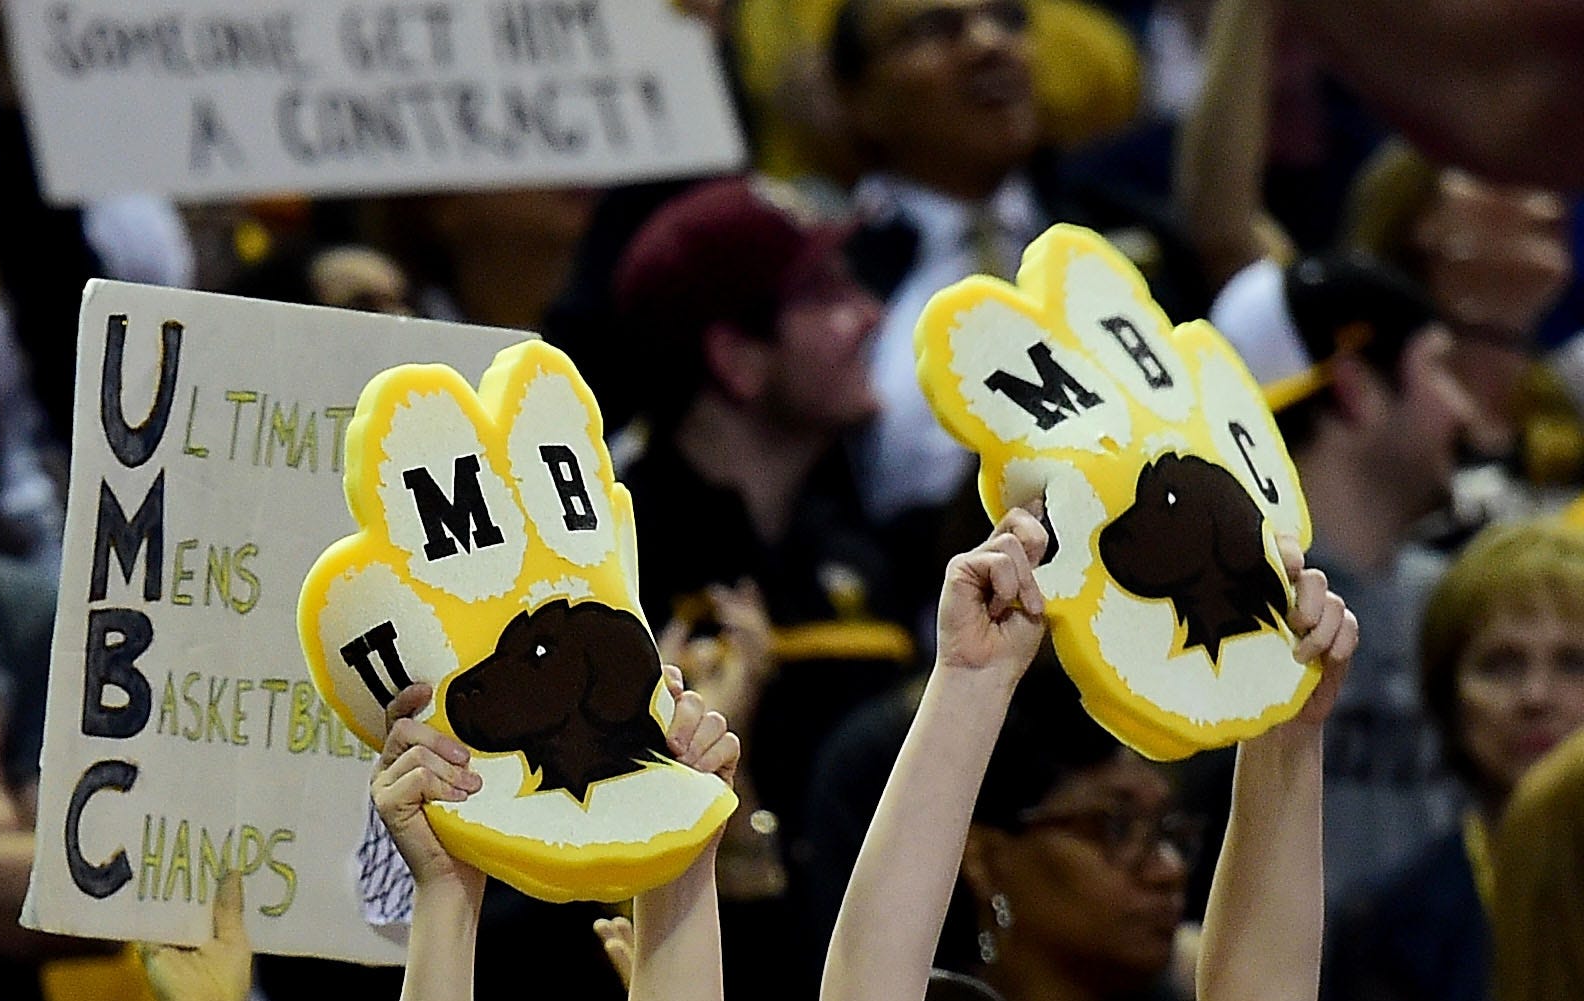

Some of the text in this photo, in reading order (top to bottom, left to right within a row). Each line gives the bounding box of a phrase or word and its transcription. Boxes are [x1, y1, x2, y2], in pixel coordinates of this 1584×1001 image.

[336, 2, 456, 72] GET
[488, 0, 612, 64] HIM
[188, 98, 248, 172] A
[100, 314, 356, 470] ULTIMAT
[88, 466, 263, 615] MENS
[81, 606, 378, 762] BASKETBAL
